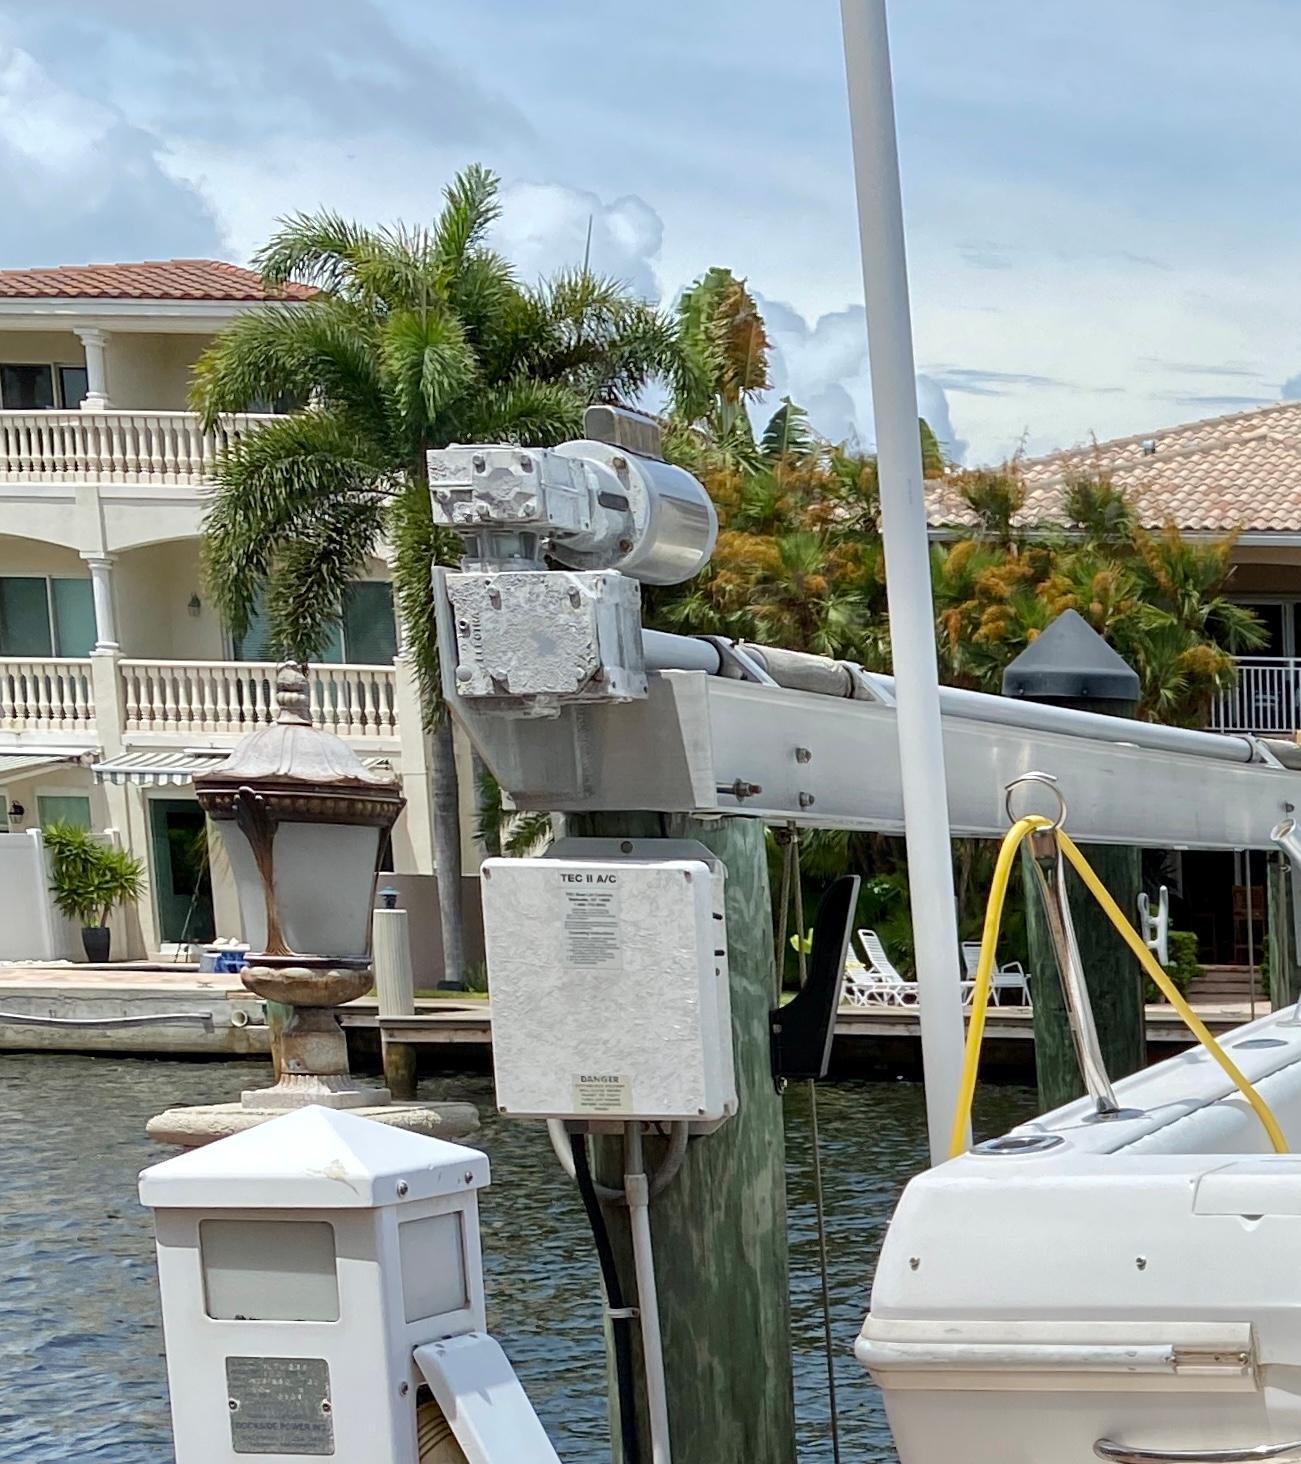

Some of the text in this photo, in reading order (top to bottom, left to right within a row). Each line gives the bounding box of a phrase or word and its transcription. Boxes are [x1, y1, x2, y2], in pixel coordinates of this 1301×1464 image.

[561, 873, 583, 883] TEC
[596, 874, 617, 884] A/C
[580, 1075, 620, 1083] DANGER
